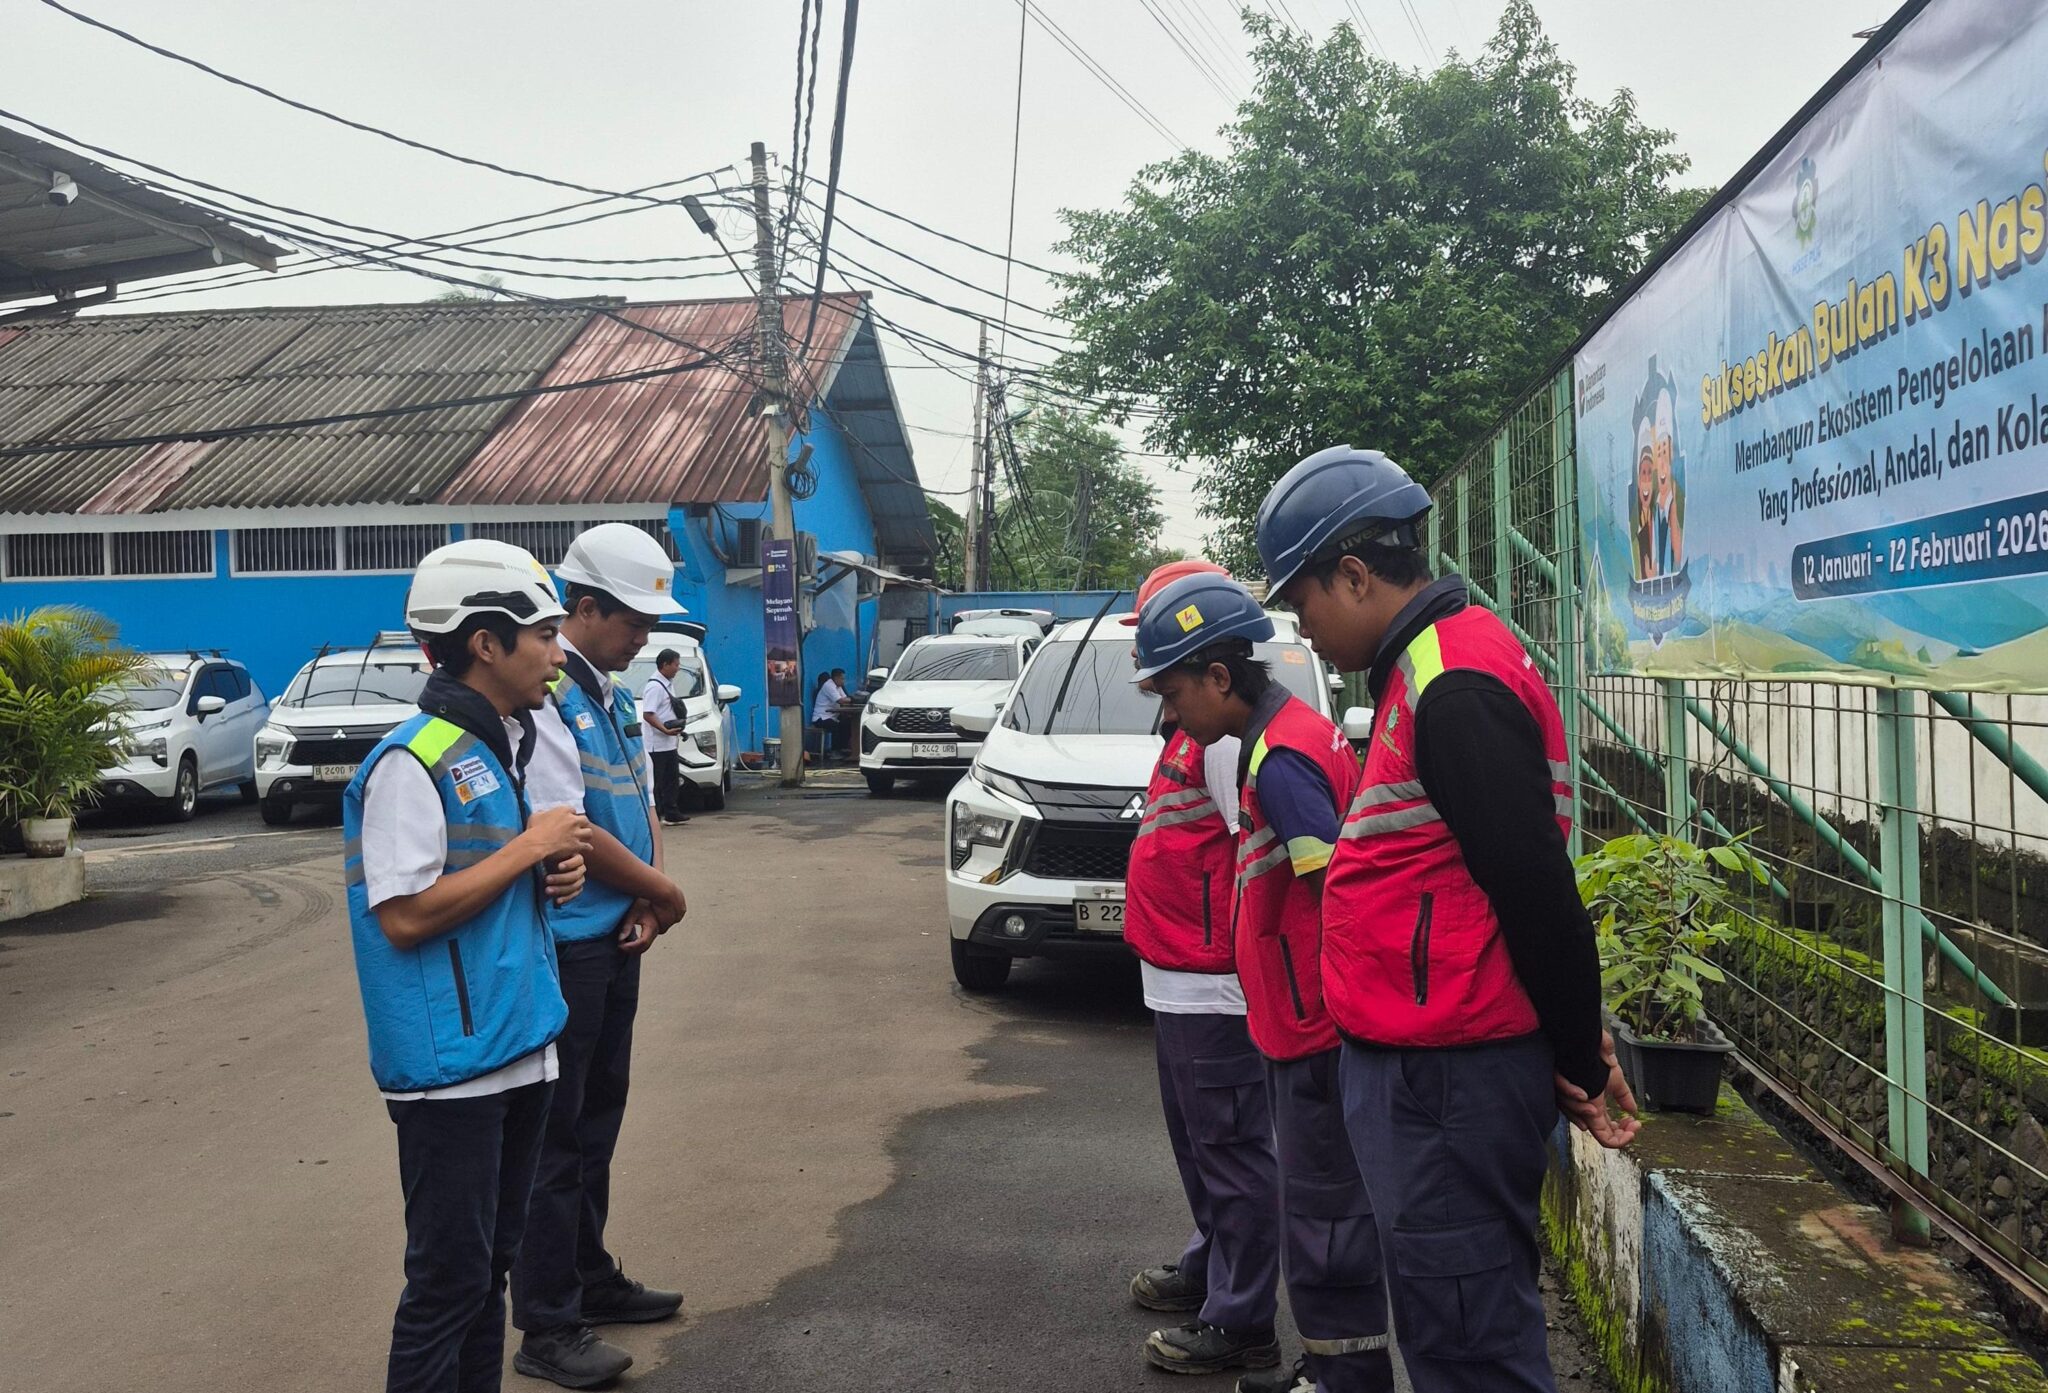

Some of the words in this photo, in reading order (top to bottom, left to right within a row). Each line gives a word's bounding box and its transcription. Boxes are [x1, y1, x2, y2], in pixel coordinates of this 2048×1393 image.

[1701, 324, 1815, 431] Sukseskan
[1814, 271, 1899, 374] Bulan
[1904, 223, 1951, 327] K3
[1958, 147, 2048, 299] Nas
[1735, 420, 1813, 474] Membangun
[1818, 384, 1893, 444] Ekosistem
[1898, 323, 2033, 411] Pengelolaan
[1758, 488, 1788, 525] Yang
[1791, 450, 1882, 513] Profesional,
[1884, 427, 1943, 488] Andal,
[1947, 419, 1990, 470] dan
[1802, 556, 1815, 585] 12
[1817, 541, 1872, 584] Januari
[1889, 539, 1905, 573] 12
[1910, 517, 1991, 570] Februari
[1997, 509, 2048, 557] 2026
[766, 597, 793, 605] Melayani
[469, 774, 490, 791] PLN
[1079, 904, 1090, 921] B
[1101, 905, 1127, 921] 22
